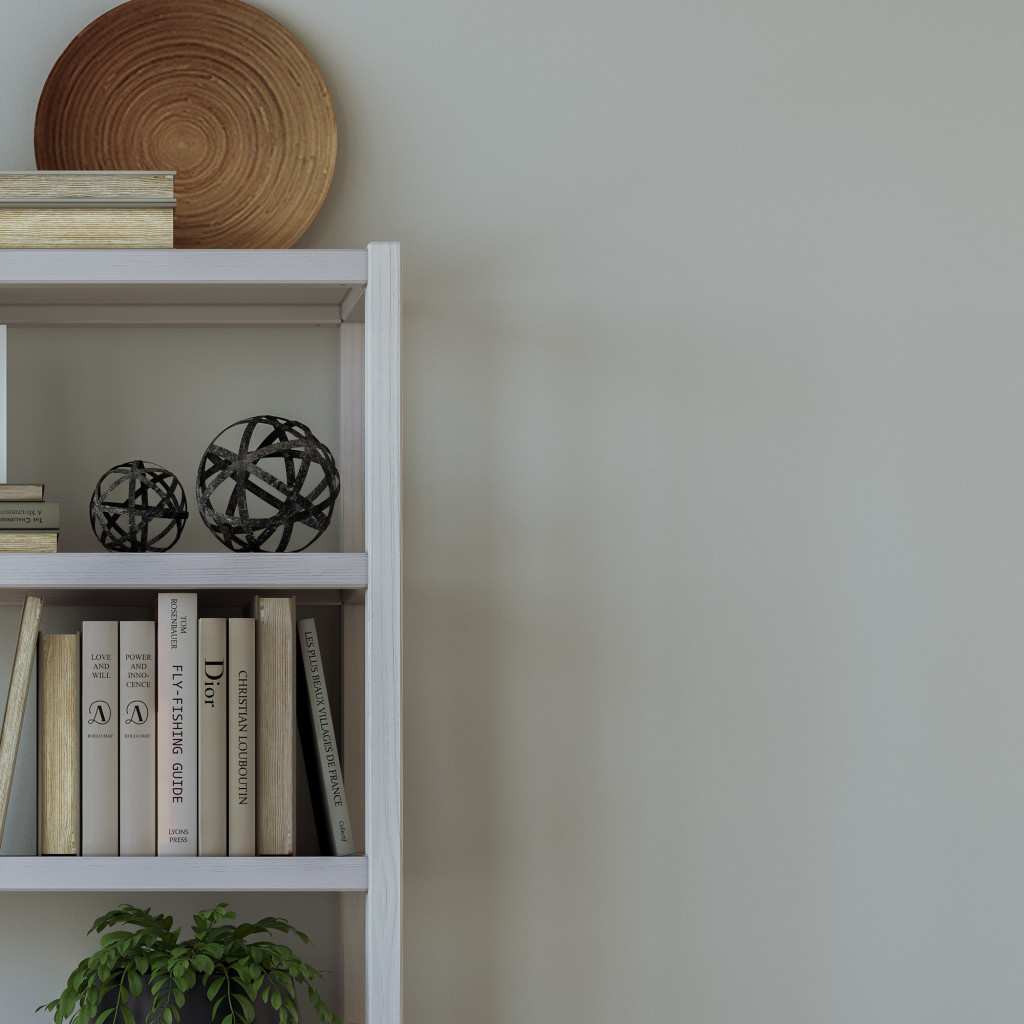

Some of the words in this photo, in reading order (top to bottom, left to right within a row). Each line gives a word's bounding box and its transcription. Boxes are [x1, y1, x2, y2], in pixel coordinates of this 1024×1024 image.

[304, 631, 314, 648] LES
[308, 650, 318, 672] PLUS
[204, 658, 225, 707] Dior
[238, 671, 248, 732] CHRISTIAN
[312, 675, 325, 706] BEAUX
[172, 665, 183, 754] FLY-FISHING
[318, 707, 333, 752] VILLAGES
[238, 736, 248, 805] LOUBOUTIN
[326, 754, 336, 767] DE
[172, 763, 183, 803] GUIDE
[328, 769, 342, 807] FRANCE
